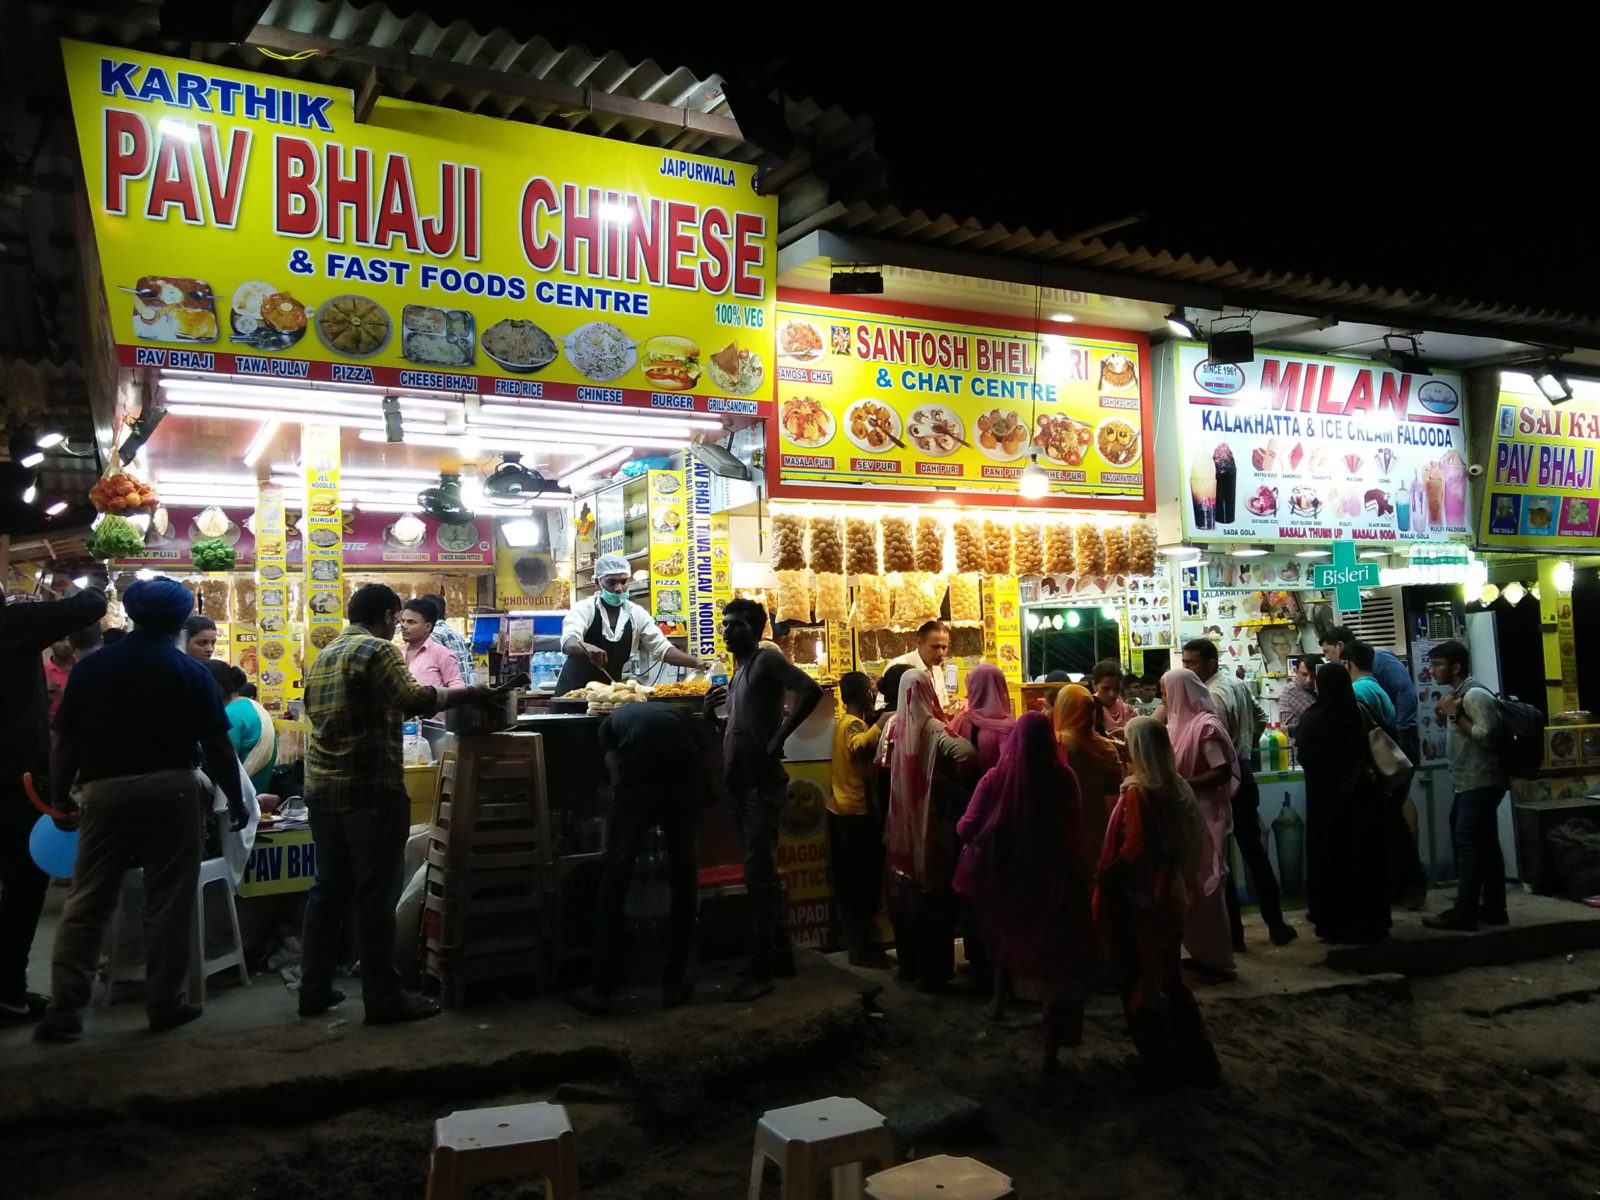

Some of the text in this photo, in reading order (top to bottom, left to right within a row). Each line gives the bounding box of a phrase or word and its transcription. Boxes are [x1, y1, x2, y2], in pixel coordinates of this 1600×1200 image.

[100, 59, 333, 131] KARTHIK
[660, 157, 735, 188] JAIPURWALA
[103, 107, 765, 299] PAV BHAJI CHINESE
[289, 249, 649, 316] & FAST FOODS CENTRE
[715, 303, 764, 328] 100% VEG
[136, 348, 214, 370] PAV BHAJI
[856, 325, 969, 370] SANTOSH
[976, 338, 1034, 376] BHEL
[236, 356, 308, 377] TAWA PULAV
[331, 365, 374, 384] PIZZA
[777, 368, 832, 384] SAMOSA CHAT
[1203, 364, 1238, 377] SINCE 1961
[400, 371, 477, 393] CHEESE BHAJI
[495, 380, 542, 397] FRIED RICE
[876, 368, 1057, 403] & CHAT CENTRE
[1259, 358, 1412, 421] MILAN
[577, 386, 623, 404] CHINESE
[652, 393, 694, 410] BURGER
[708, 398, 758, 415] GRILL SANDWICH
[1202, 409, 1302, 437] KALAKHATTA
[1306, 417, 1316, 438] &
[1321, 419, 1343, 440] ICE
[1397, 424, 1454, 448] FALOODA
[1518, 405, 1563, 437] SAI
[784, 457, 832, 468] MASALA PURI
[856, 459, 897, 472] SEV PURI
[921, 464, 960, 475] DAHI PURI
[983, 467, 1004, 477] PANI
[1494, 440, 1596, 491] PAV BHAJI
[1066, 472, 1086, 482] PURI
[1223, 528, 1256, 537] SADA GOLA
[1279, 526, 1344, 539] MASALA THUMS UP
[1352, 528, 1397, 540] MASALA SODA
[1400, 532, 1416, 540] MALAI
[152, 551, 178, 559] PURI
[687, 545, 696, 583] NOODLES
[693, 458, 715, 656] AV BHAJI TAVA PULAV NOODLES
[1322, 564, 1369, 587] Bisleri
[504, 595, 554, 606] CHOCOLATE
[689, 585, 697, 607] PIZZA
[689, 611, 698, 646] BURGER
[244, 846, 283, 883] PAV
[777, 842, 828, 865] RAGDA
[783, 866, 832, 889] ATTICE
[788, 903, 829, 926] APADI
[790, 926, 829, 947] HAAT
